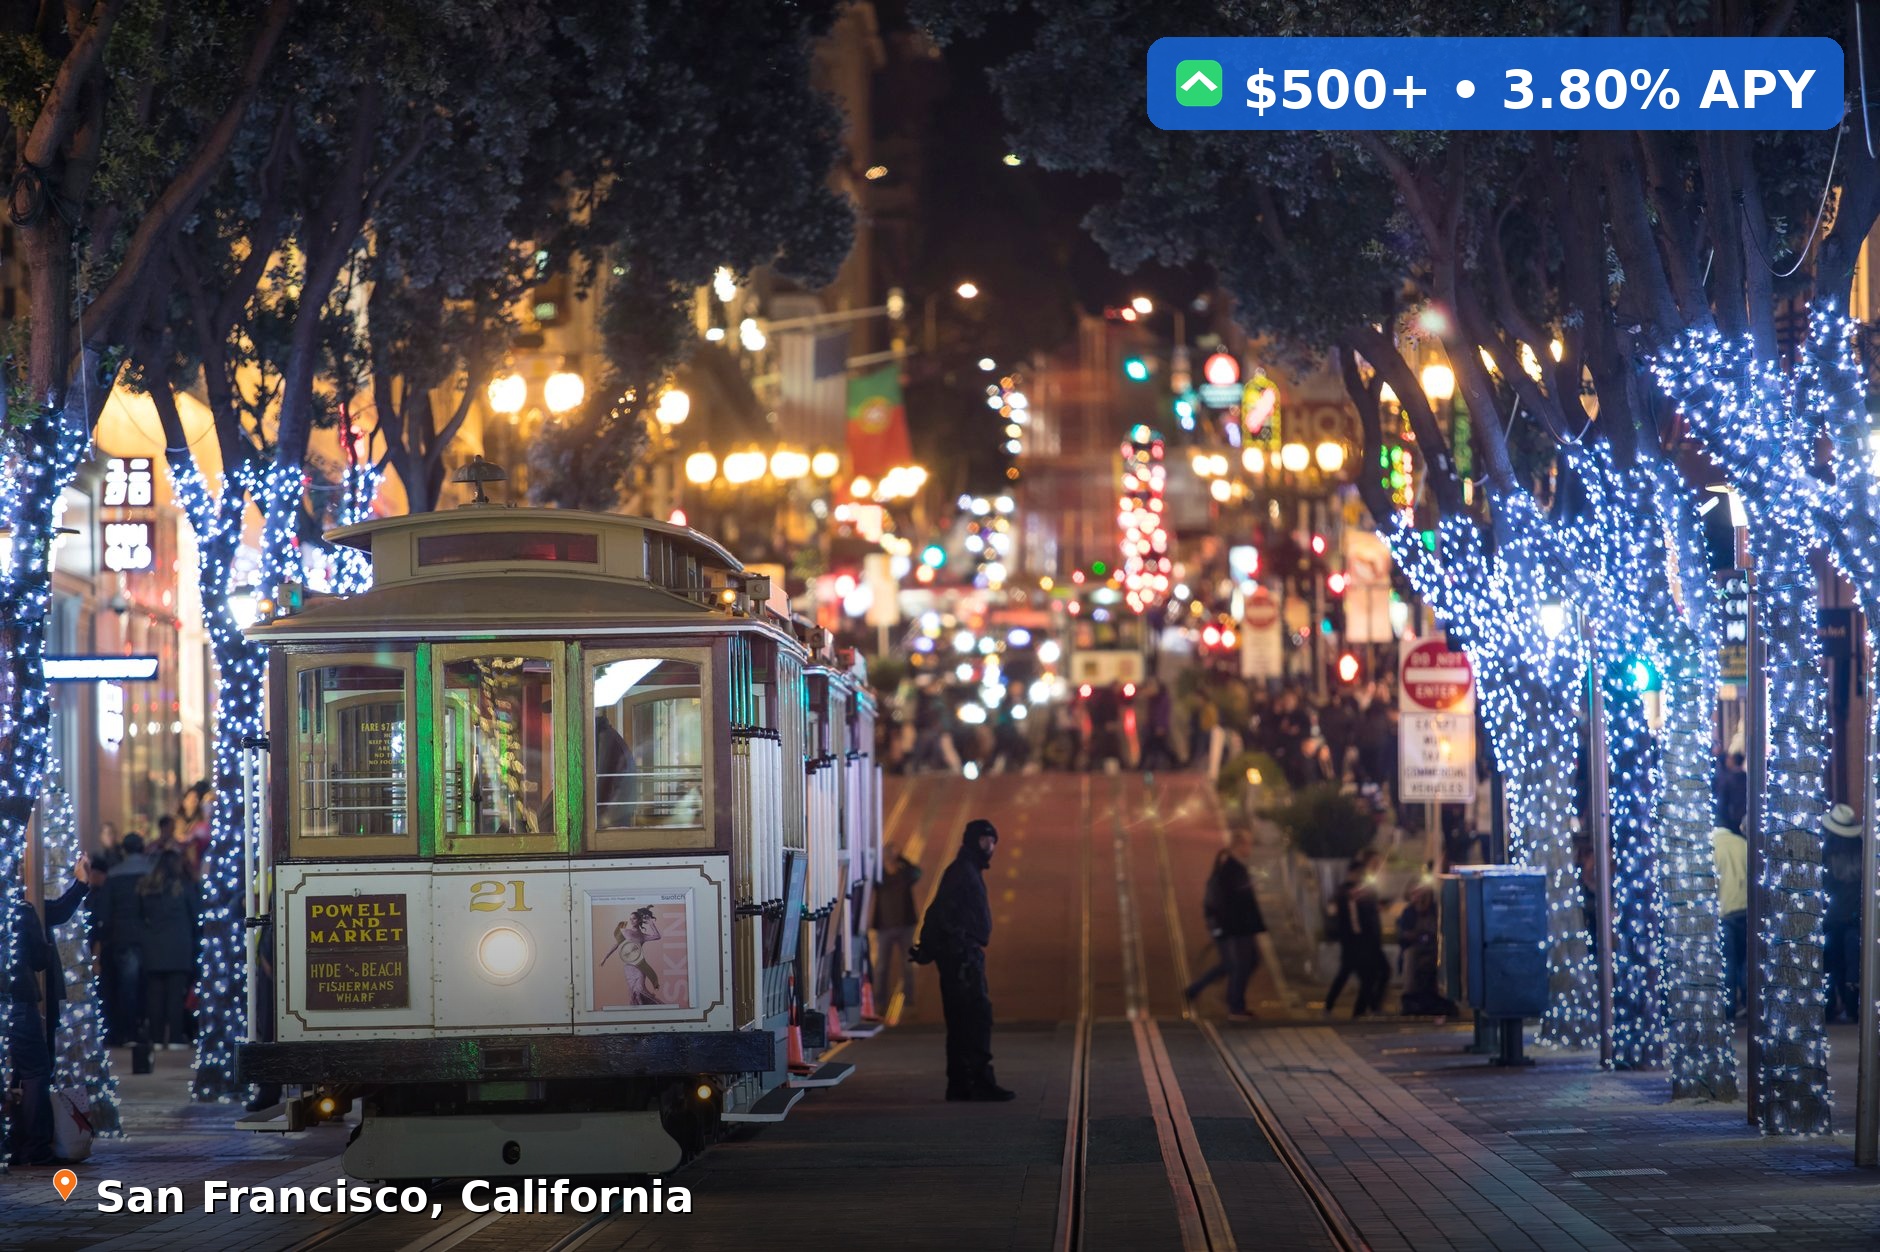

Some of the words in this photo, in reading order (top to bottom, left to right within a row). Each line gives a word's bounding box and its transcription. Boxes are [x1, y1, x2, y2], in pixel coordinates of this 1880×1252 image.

[470, 880, 532, 912] 21
[311, 903, 401, 918] POWELL
[336, 917, 380, 929] AND
[310, 928, 403, 943] MARKET
[662, 912, 688, 1002] SKIN
[311, 963, 341, 978] HYDE
[345, 964, 359, 977] AND
[361, 962, 402, 977] BEACH
[318, 980, 394, 992] FISHERMANS
[337, 993, 376, 1002] WHARF
